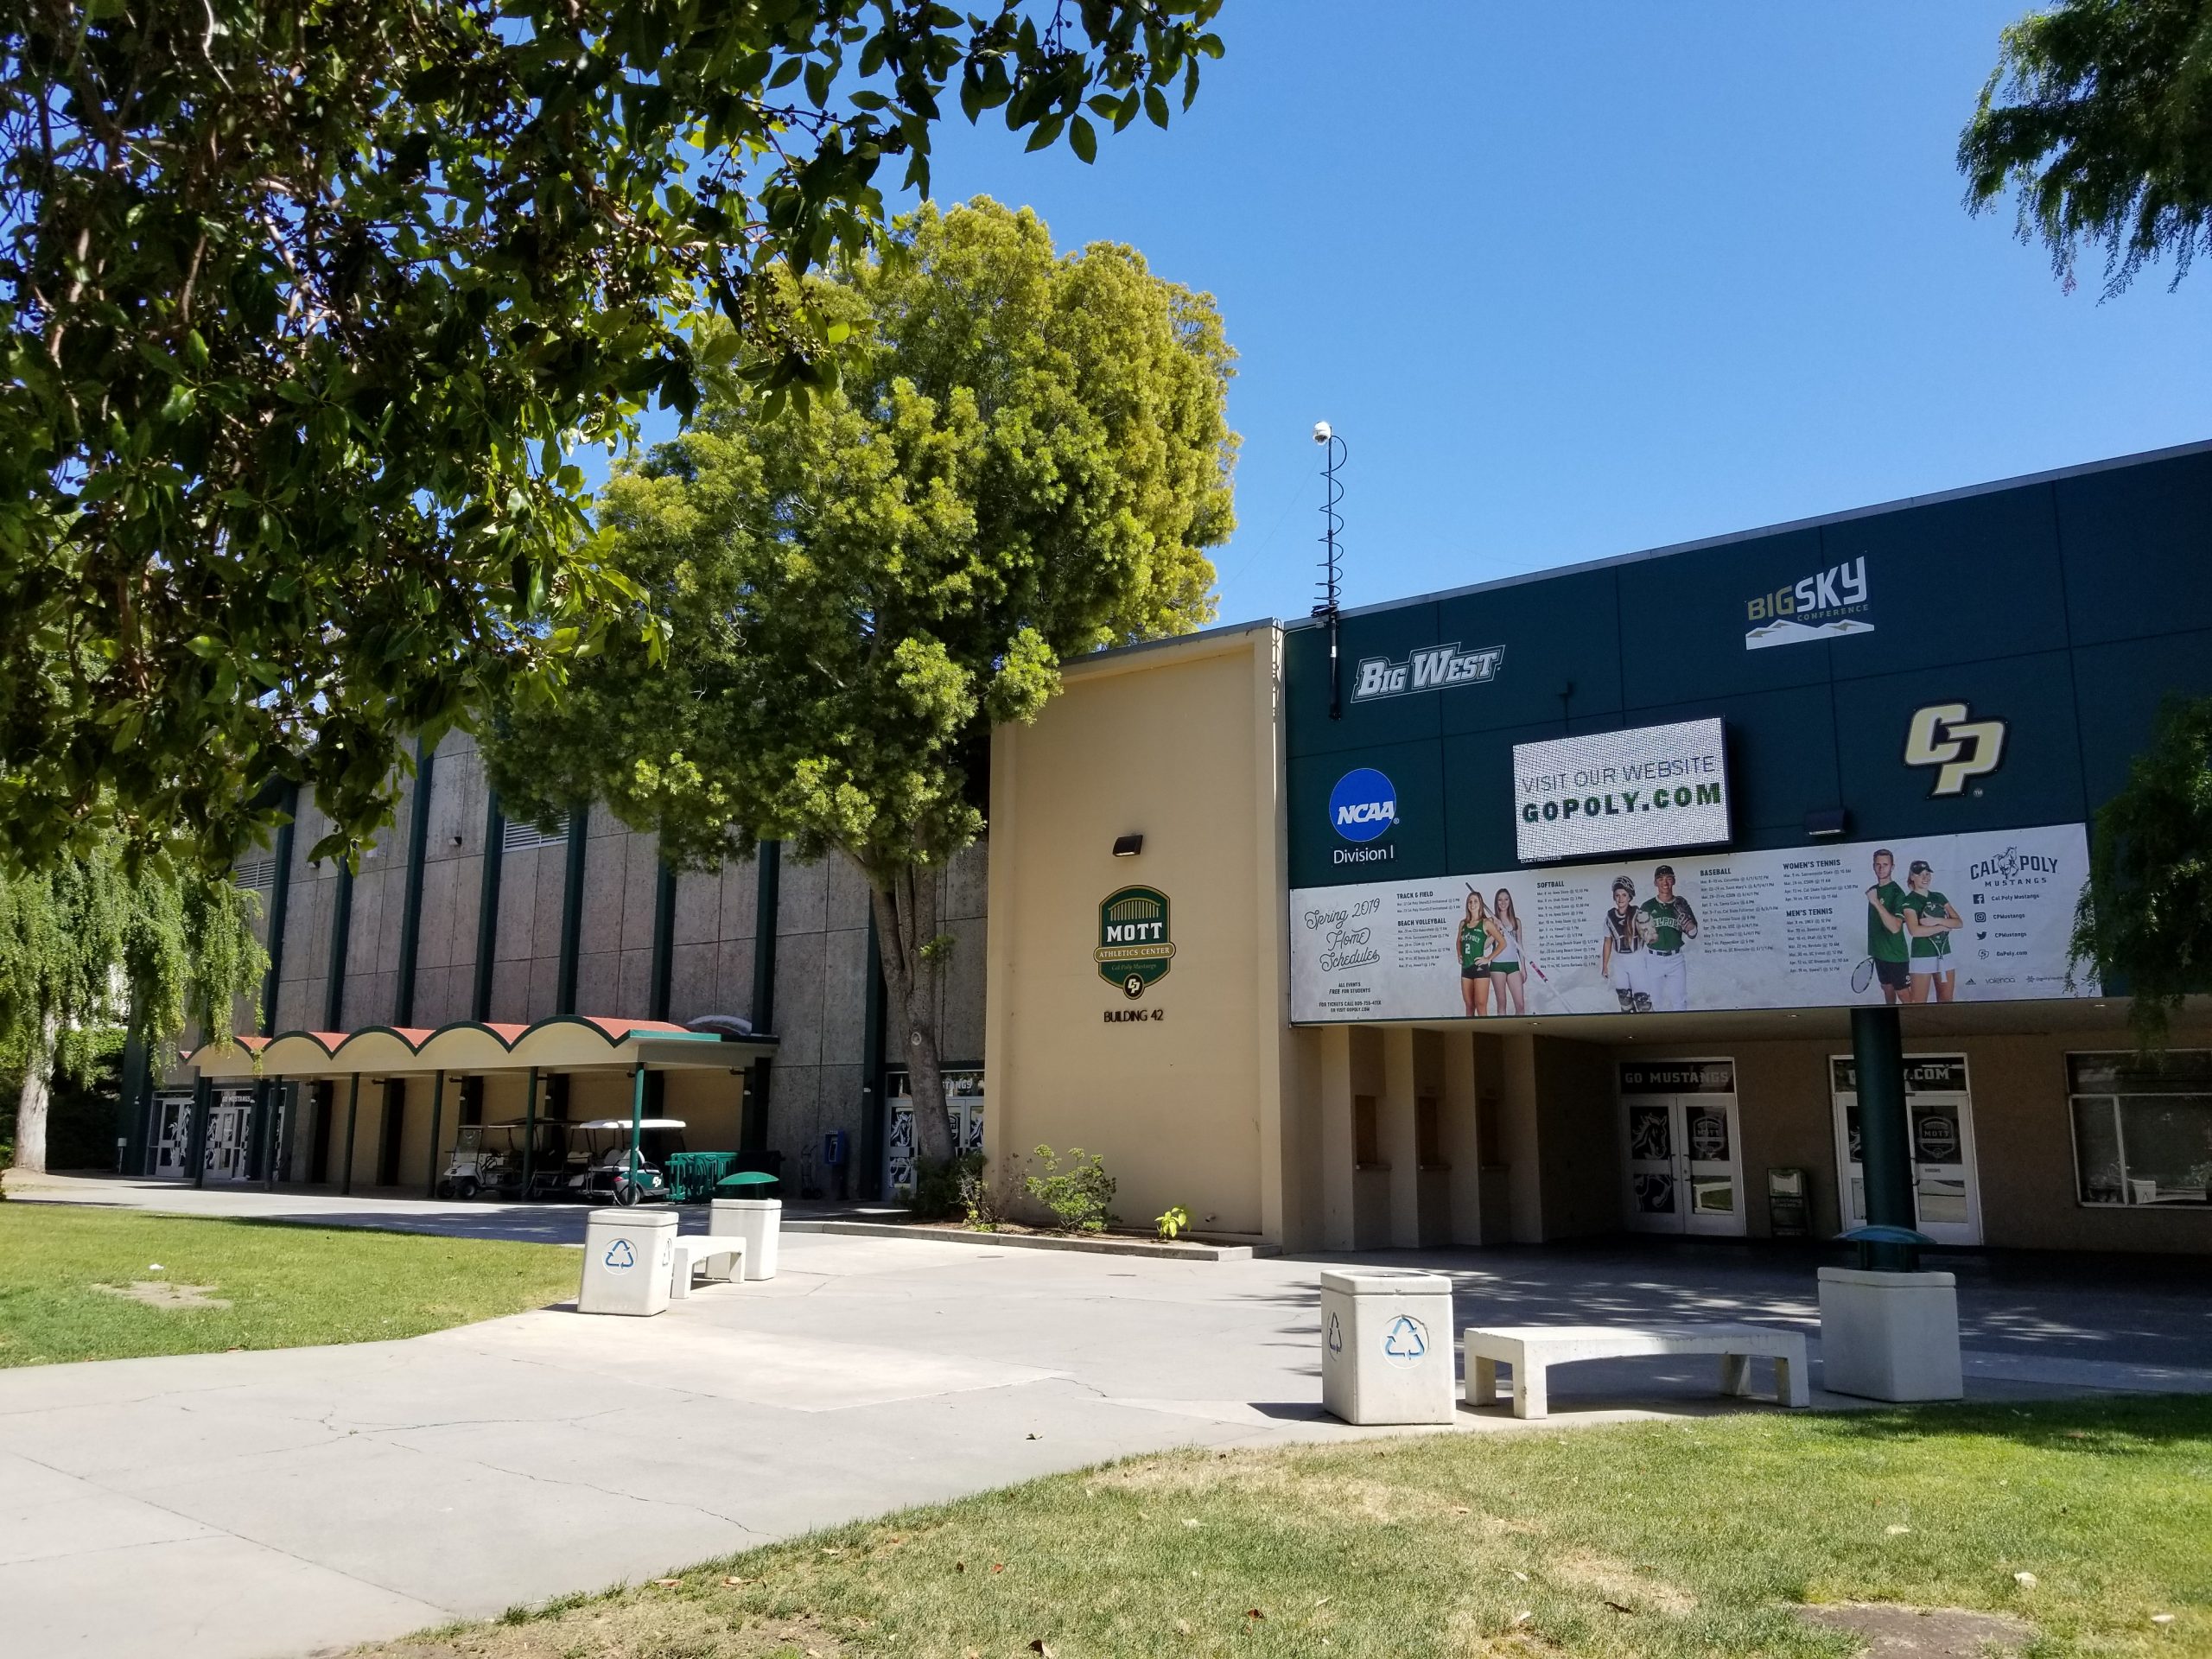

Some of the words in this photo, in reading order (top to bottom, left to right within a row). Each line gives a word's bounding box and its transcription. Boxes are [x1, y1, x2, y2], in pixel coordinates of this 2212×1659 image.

[1797, 605, 1869, 621] CONFERENCE
[1522, 773, 1567, 792] VISIT
[1575, 768, 1616, 787] OUR
[1623, 756, 1714, 781] WEBSITE
[1522, 782, 1720, 822] GOPOLY.COM
[1337, 801, 1395, 824] NCAA
[1334, 848, 1386, 864] Division
[1700, 868, 1731, 876] BASEBALL
[1783, 861, 1814, 869] WOMEN'S
[1971, 859, 1998, 880] CAL
[2020, 856, 2058, 873] POLY
[1985, 878, 2047, 887] MUSTANGS
[1305, 910, 1349, 930] Spring
[1352, 898, 1380, 917] 2019
[1106, 922, 1162, 942] MOTT
[1326, 927, 1370, 951] Home
[1099, 949, 1138, 958] ATHLETICS
[1465, 943, 1470, 954] 2
[1320, 947, 1380, 971] Schedules
[1104, 1010, 1147, 1022] BUILDING
[1151, 1010, 1163, 1021] 42
[1625, 1073, 1642, 1083] GO
[1650, 1072, 1728, 1083] MUSTANGS
